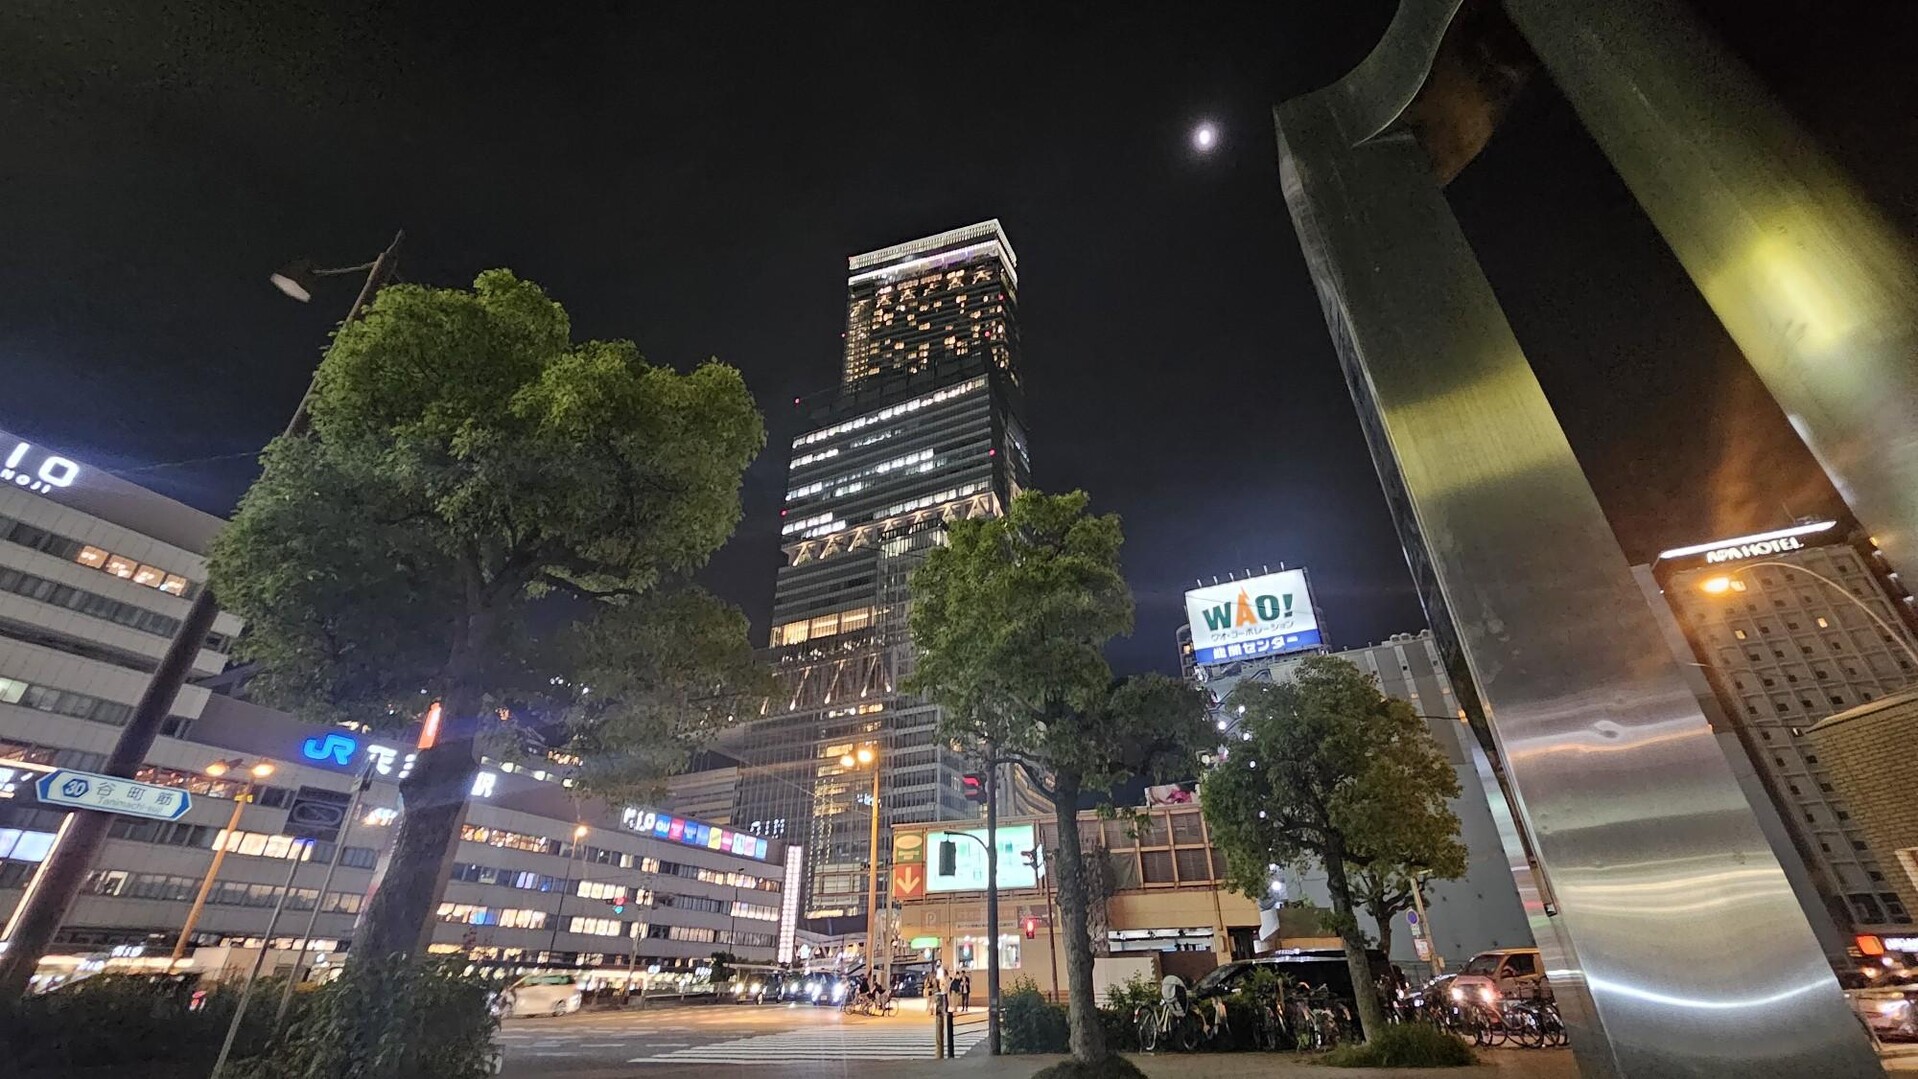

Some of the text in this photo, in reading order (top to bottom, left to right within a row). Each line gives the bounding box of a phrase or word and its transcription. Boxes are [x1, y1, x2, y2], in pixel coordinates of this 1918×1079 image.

[1706, 537, 1804, 564] APA HOTEL
[1202, 586, 1293, 631] WAO!
[303, 733, 357, 766] JR
[63, 782, 86, 797] 30
[96, 781, 174, 806] 谷町筋
